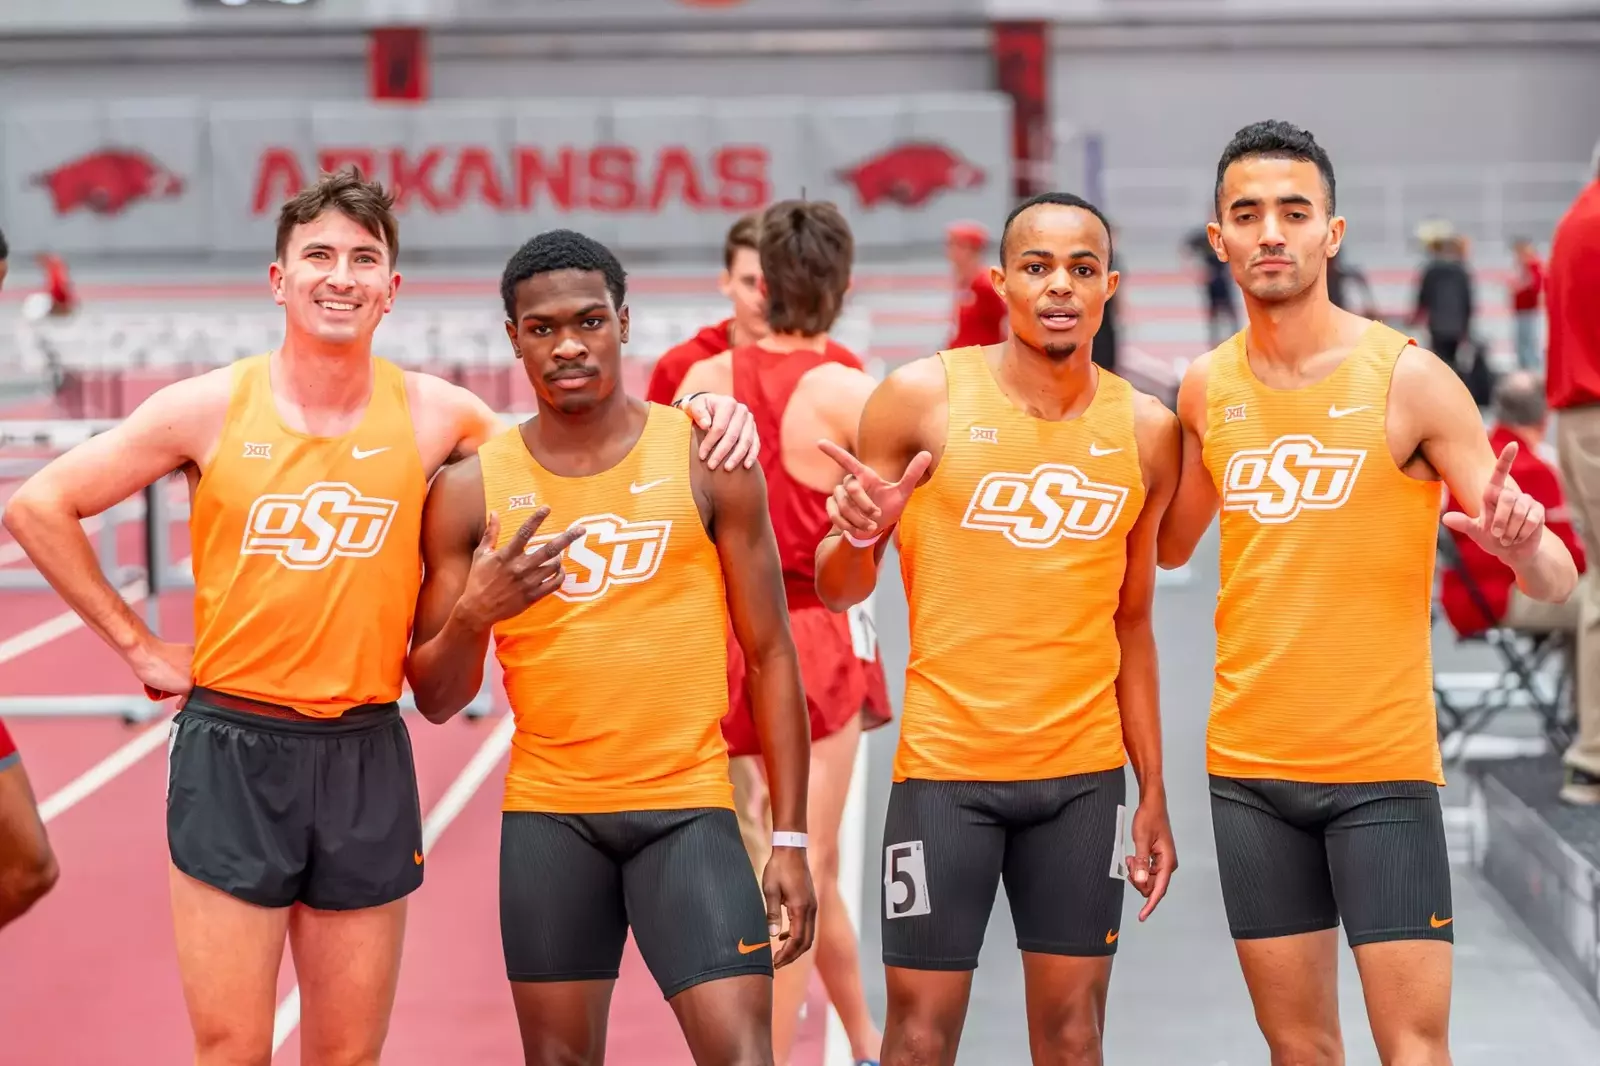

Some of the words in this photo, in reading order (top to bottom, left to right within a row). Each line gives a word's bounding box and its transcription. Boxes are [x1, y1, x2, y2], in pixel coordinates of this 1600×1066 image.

[966, 468, 1122, 543] OSU
[1224, 440, 1359, 518] OSU
[245, 486, 394, 566] OSU
[523, 516, 668, 598] SU
[892, 847, 916, 913] 5
